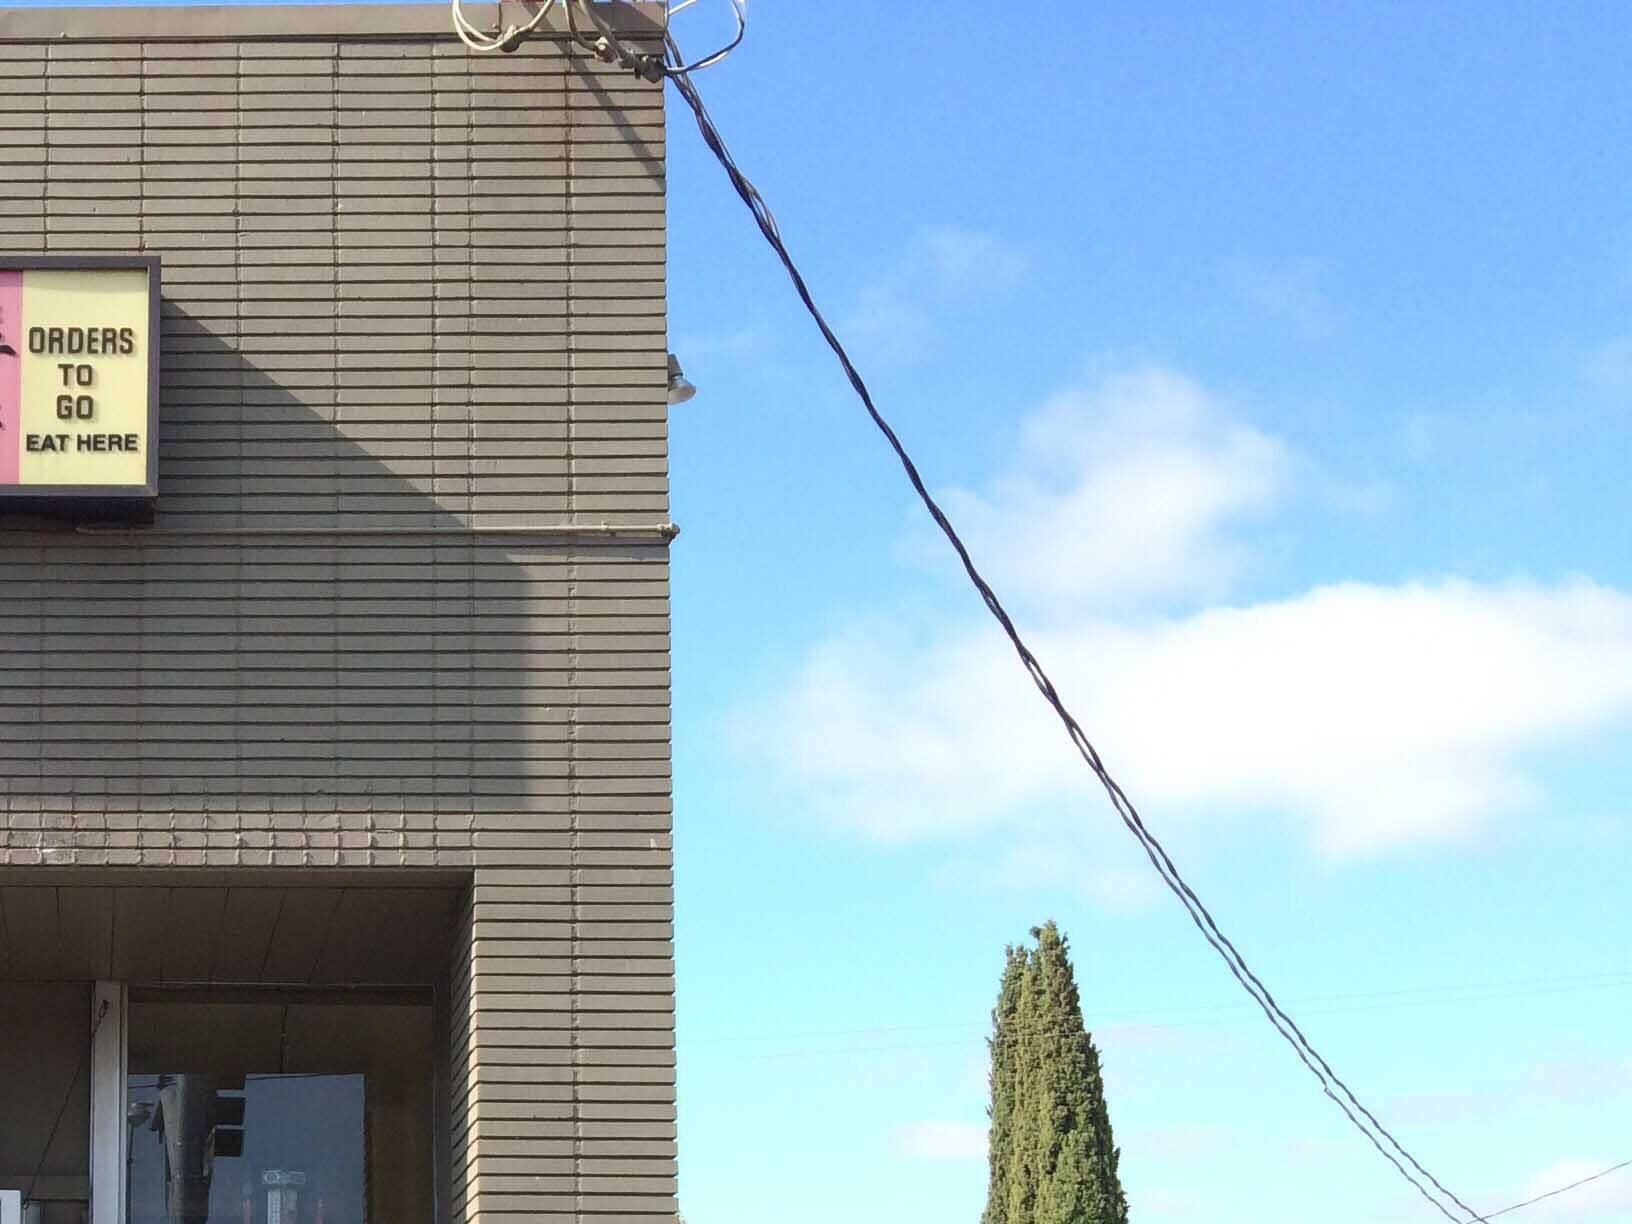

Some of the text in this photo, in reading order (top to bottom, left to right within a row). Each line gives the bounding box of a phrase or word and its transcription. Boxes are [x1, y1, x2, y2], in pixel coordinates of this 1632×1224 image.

[28, 326, 134, 355] ORDERS
[57, 363, 94, 387] TO
[56, 394, 95, 420] GO
[25, 433, 139, 453] EAT HERE
